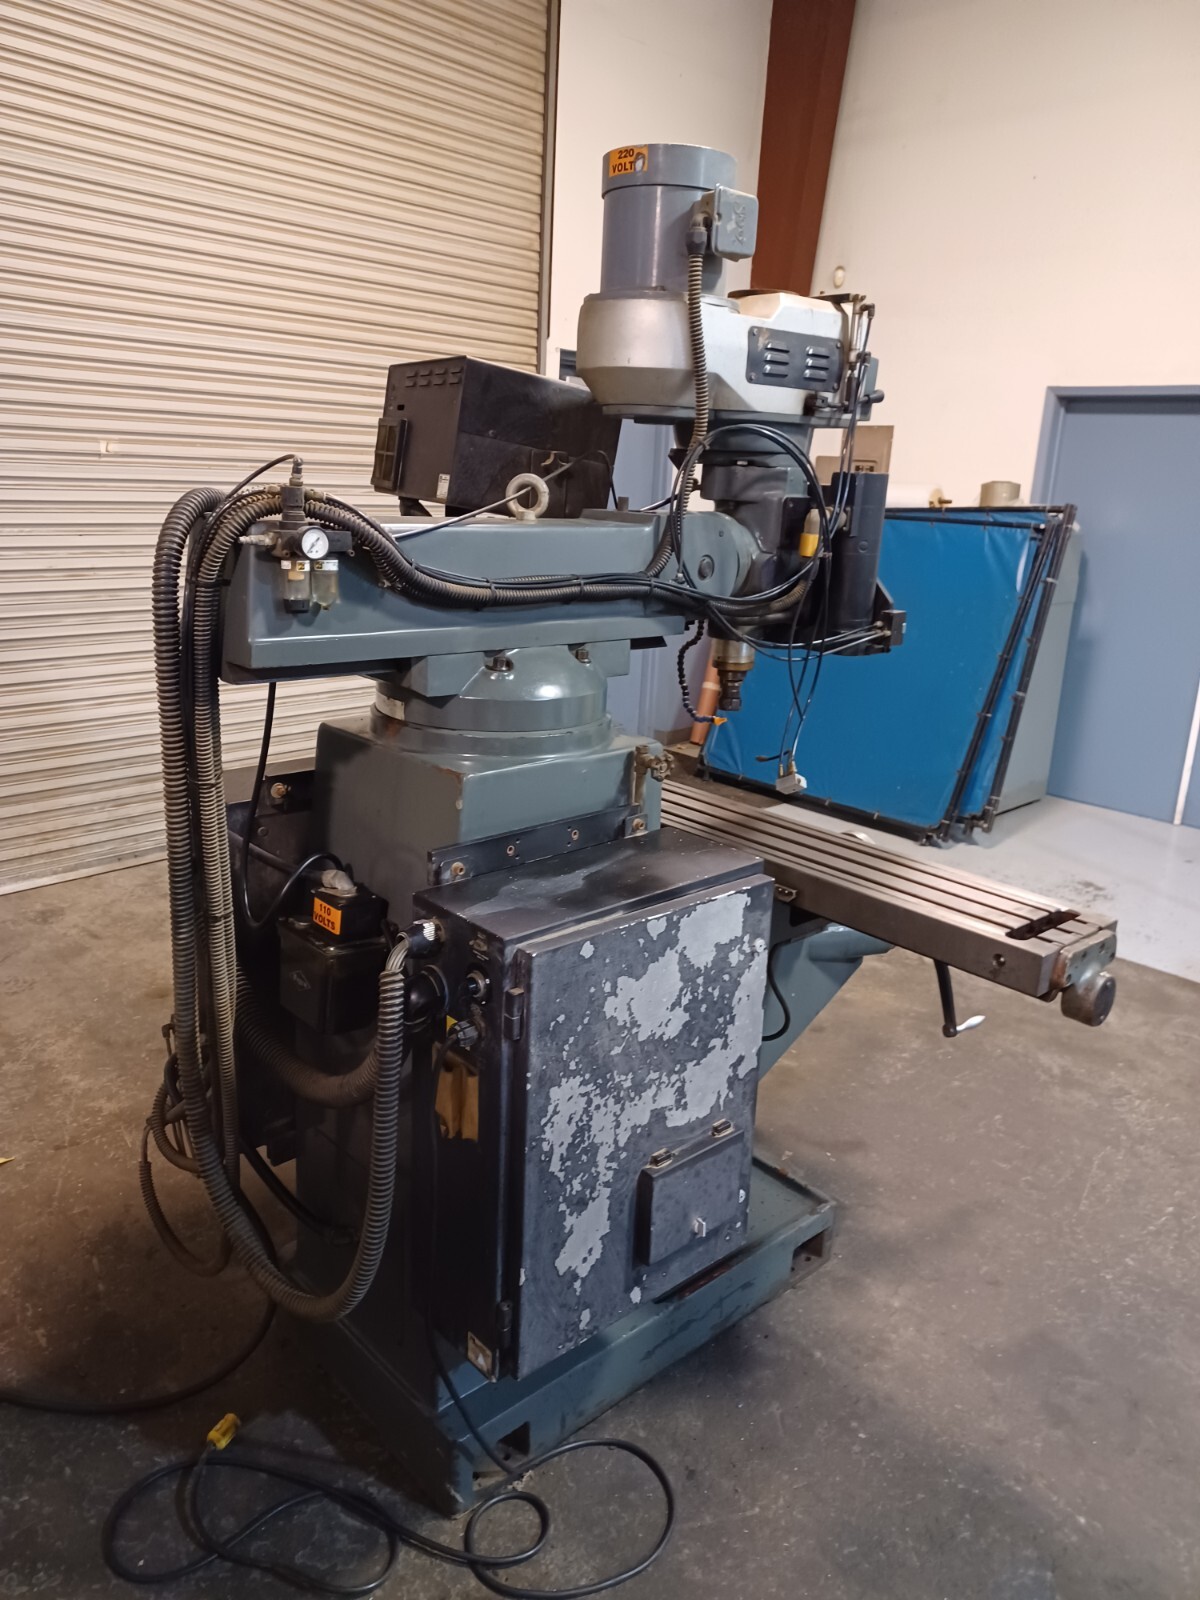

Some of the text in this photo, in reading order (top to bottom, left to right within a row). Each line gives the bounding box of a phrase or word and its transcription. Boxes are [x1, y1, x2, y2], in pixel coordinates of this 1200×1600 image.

[618, 148, 635, 160] 220
[612, 161, 639, 174] VOLT
[319, 903, 332, 916] 110
[313, 912, 336, 931] VOLTS
